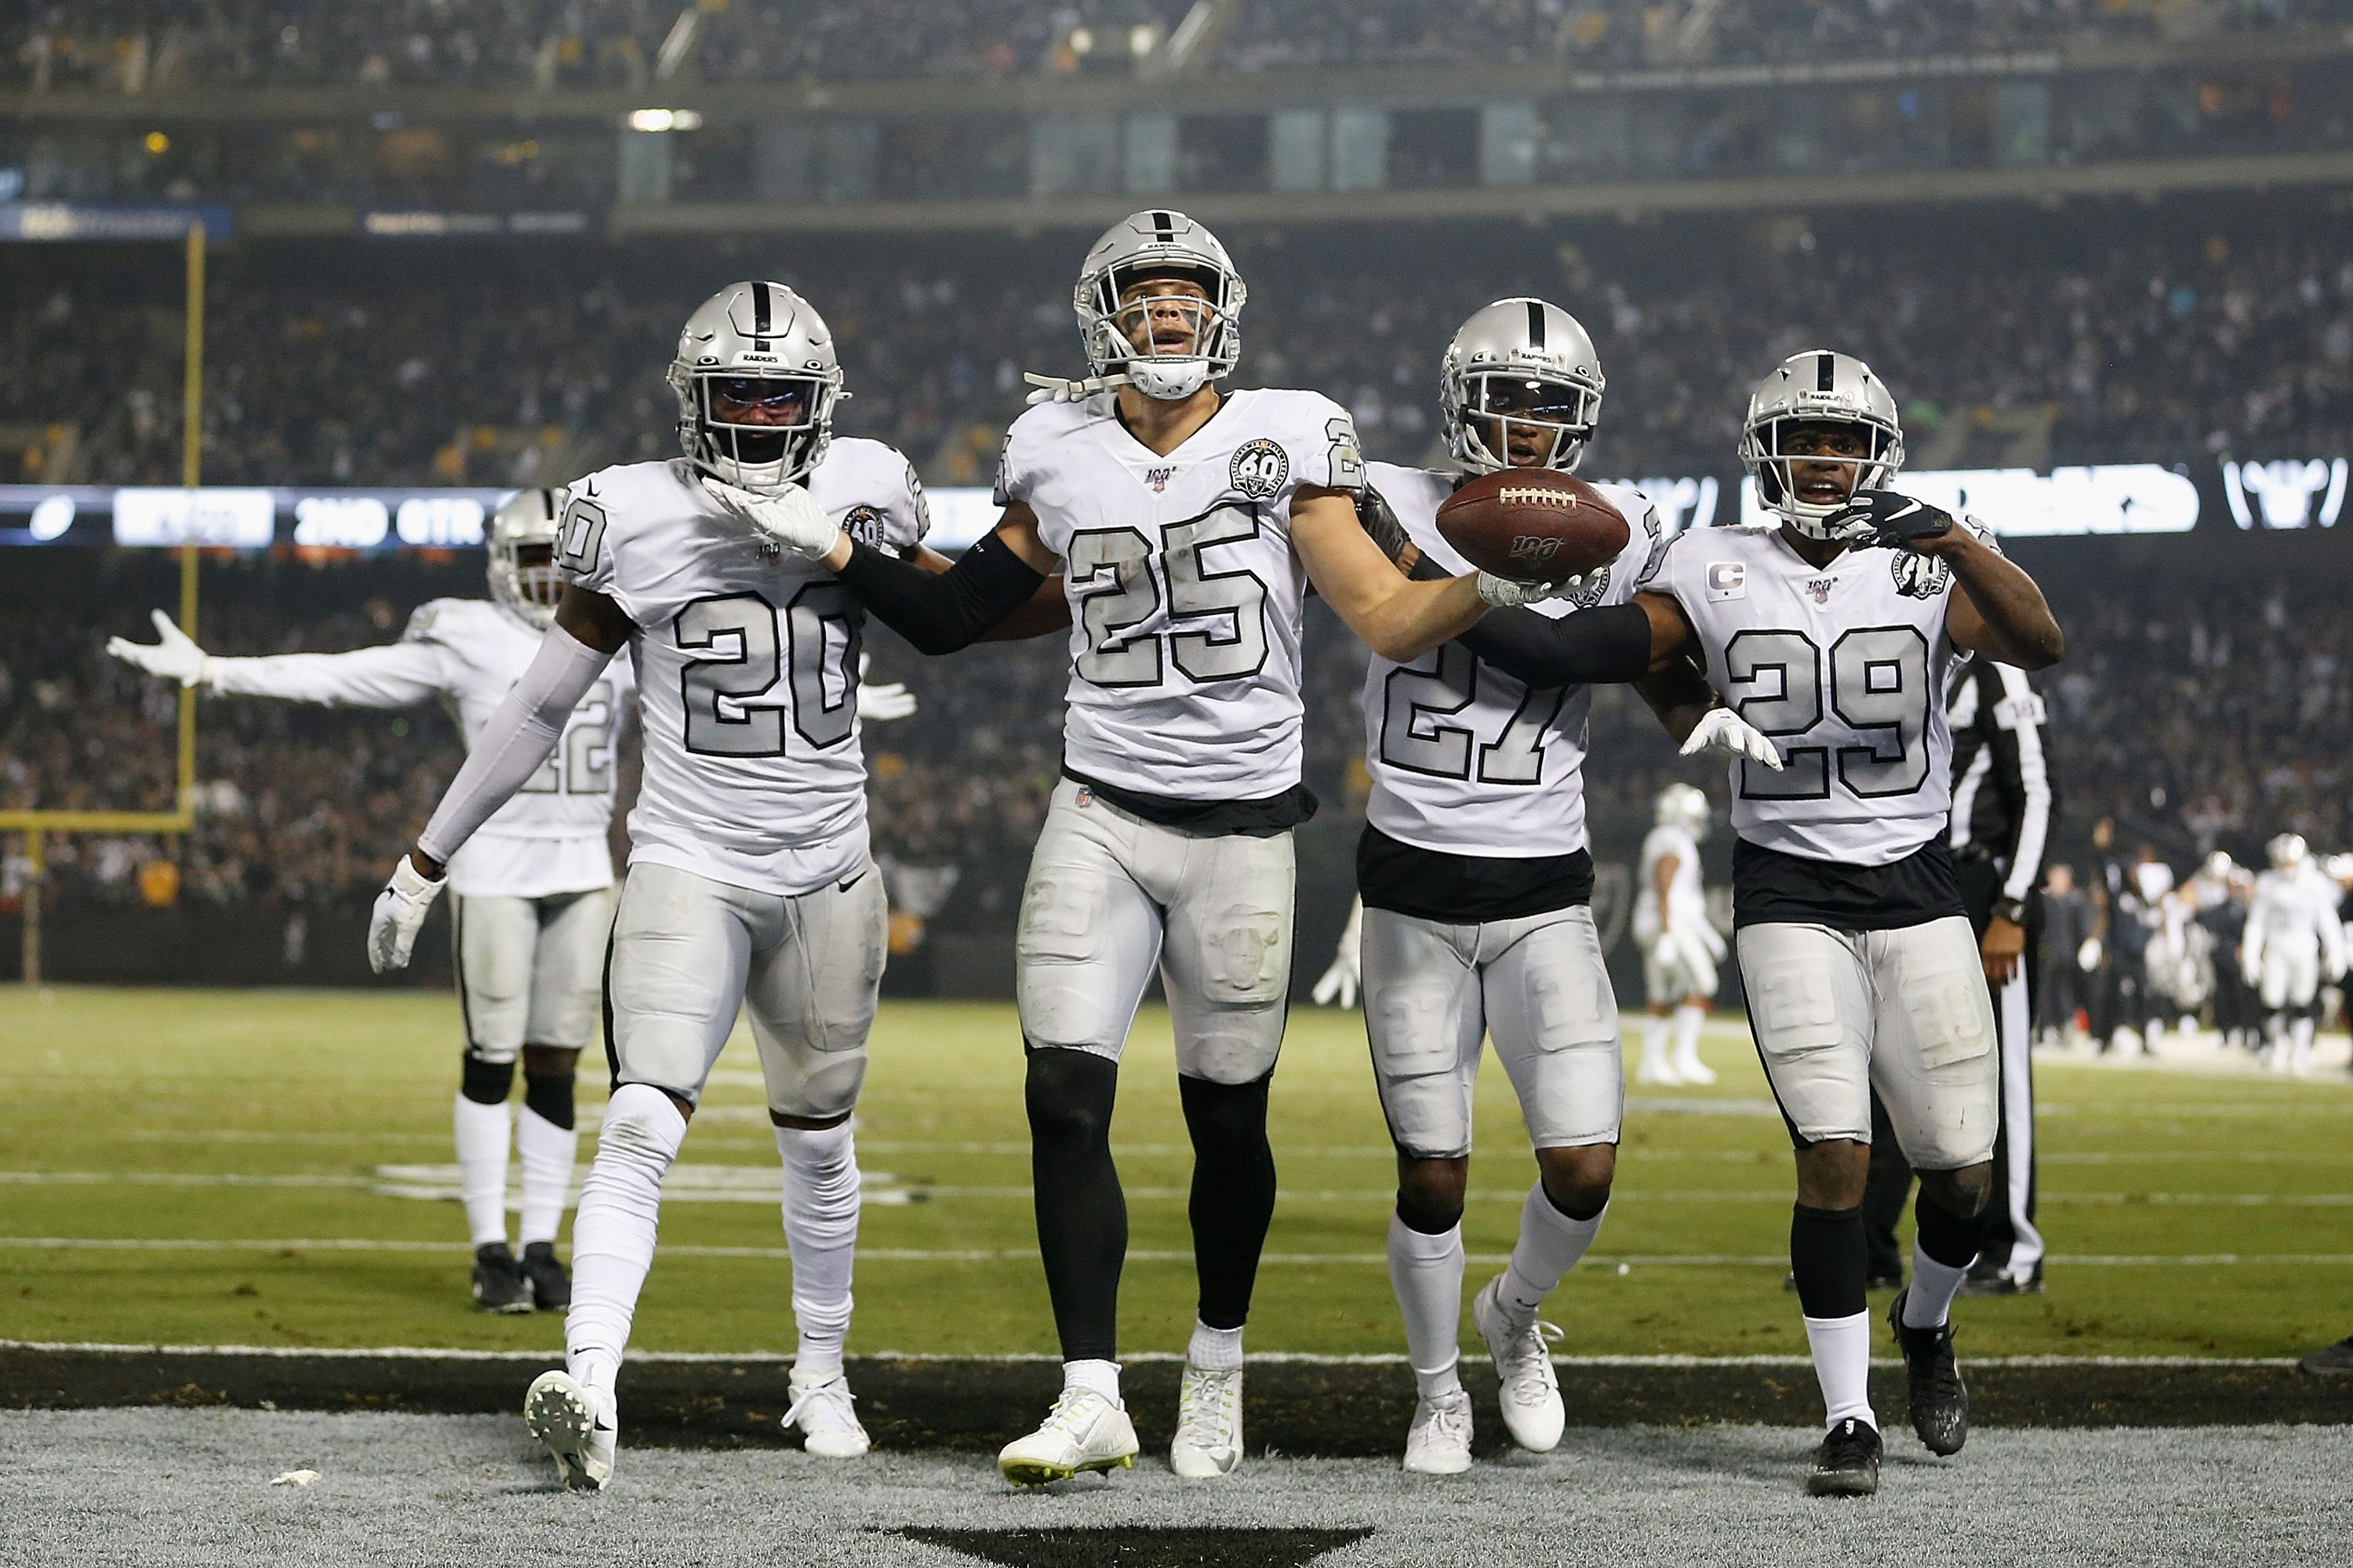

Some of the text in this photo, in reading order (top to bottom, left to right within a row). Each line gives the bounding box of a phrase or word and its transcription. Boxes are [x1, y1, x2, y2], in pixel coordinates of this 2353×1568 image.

[743, 354, 779, 363] RAIDERS
[1239, 452, 1280, 482] 60
[552, 497, 607, 576] 0
[1708, 564, 1744, 590] C
[1067, 500, 1270, 687] 25
[674, 580, 864, 758] 20
[1380, 645, 1569, 784] 27
[1725, 624, 1930, 800] 29
